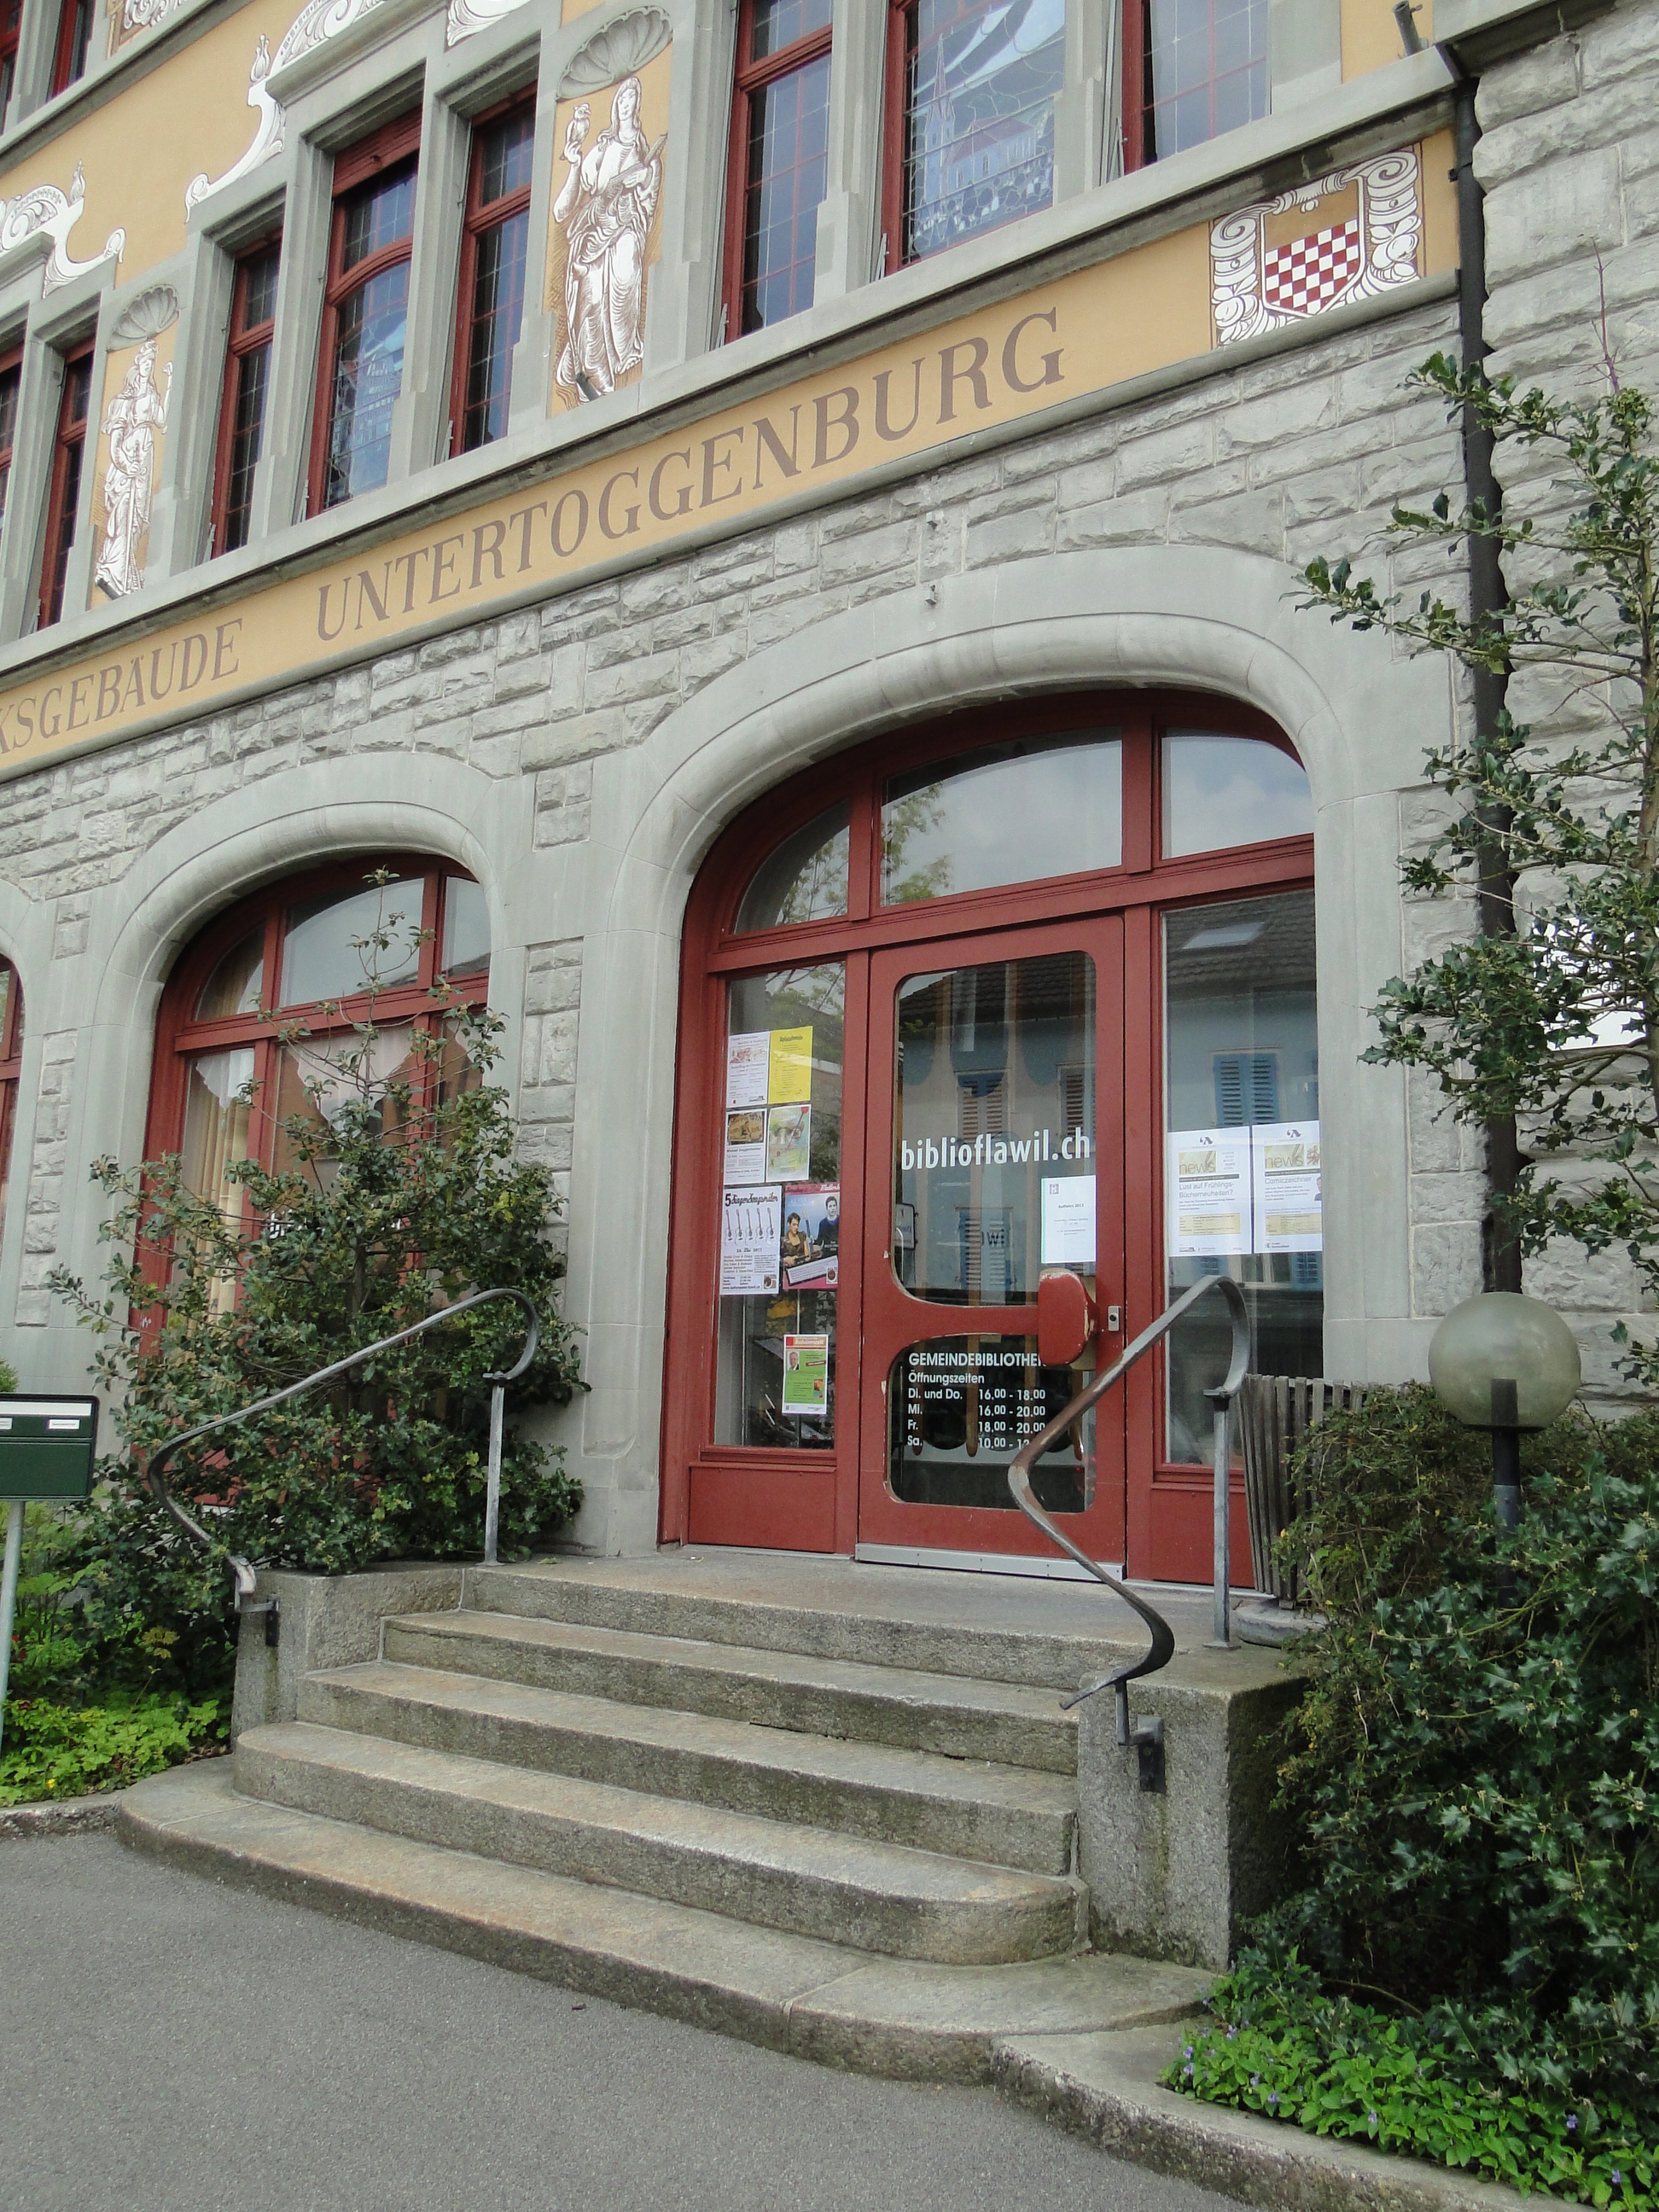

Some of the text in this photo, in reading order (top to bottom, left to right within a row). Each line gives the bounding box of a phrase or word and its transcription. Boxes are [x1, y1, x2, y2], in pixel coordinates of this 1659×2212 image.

[317, 306, 1065, 641] UNTERTOGGENBURG
[901, 1126, 1091, 1171] biblioflawil.ch
[1179, 1161, 1215, 1175] news
[1265, 1155, 1303, 1168] news
[908, 1370, 985, 1386] Öffnungszeiten
[908, 1388, 921, 1400] Di.
[924, 1388, 943, 1400] und
[946, 1388, 963, 1400] Do.
[979, 1388, 1006, 1400] 16.00
[1016, 1388, 1045, 1401] 18.00
[908, 1404, 923, 1415] Mi.
[979, 1405, 1006, 1417] 16.00
[1016, 1406, 1045, 1417] 20.00
[907, 1419, 918, 1430] Fr.
[978, 1421, 1006, 1433] 18.00
[907, 1435, 923, 1447] Sa.
[978, 1437, 1006, 1449] 10.00
